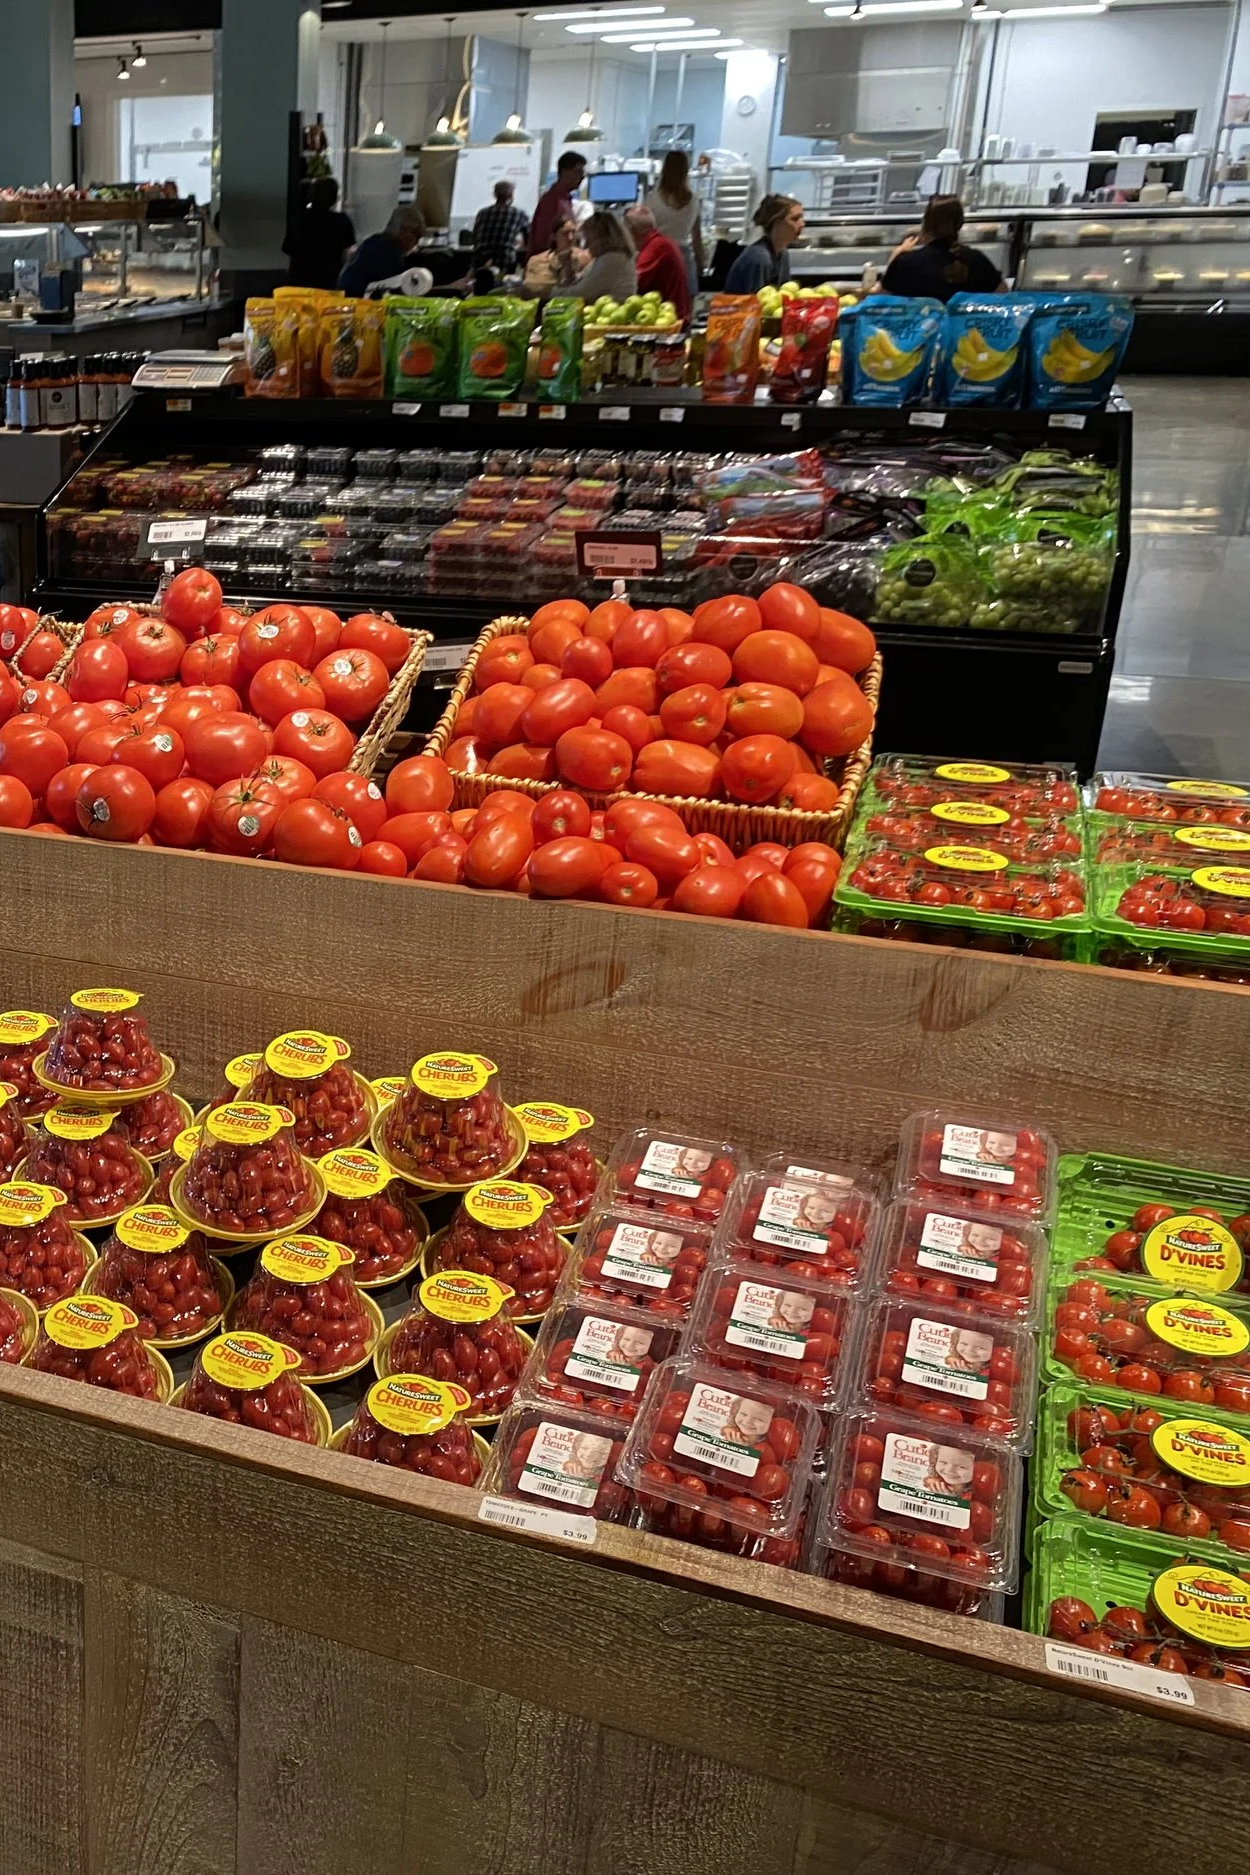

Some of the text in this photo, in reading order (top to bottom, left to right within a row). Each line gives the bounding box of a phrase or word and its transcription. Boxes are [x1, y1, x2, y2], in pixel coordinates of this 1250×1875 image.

[273, 1044, 327, 1065] CHERUBS
[286, 1039, 326, 1053] NATURESWEET
[419, 1068, 478, 1082] CHERUBS
[427, 1061, 472, 1072] NATURESWEET
[50, 1116, 103, 1125] CHERUBS
[214, 1113, 272, 1130] CHERUBS
[226, 1109, 270, 1120] NATURESWEET
[323, 1160, 381, 1183] CHERUBS
[335, 1155, 378, 1172] NATURESWEET
[1, 1190, 43, 1201] NATURESWEET
[472, 1196, 532, 1212] CHERUBS
[480, 1191, 528, 1201] NATURESWEET
[123, 1218, 180, 1237] CHERUBS
[135, 1213, 178, 1225] NATURESWEET
[283, 1242, 328, 1258] NATURESWEET
[1169, 1237, 1220, 1251] NATURESWEET
[270, 1246, 327, 1270] CHERUBS
[1160, 1245, 1226, 1270] D'VINES
[437, 1280, 486, 1294] NATURESWEET
[426, 1286, 492, 1308] CHERUBS
[68, 1303, 111, 1320] NATURESWEET
[54, 1308, 111, 1334] CHERUBS
[1164, 1316, 1233, 1338] D'VINES
[226, 1340, 272, 1360] NATURESWEET
[211, 1345, 271, 1374] CHERUBS
[912, 1361, 977, 1380] Grape Tomatoes
[389, 1384, 440, 1401] NATURESWEET
[375, 1391, 444, 1417] CHERUBS
[687, 1429, 750, 1455] Grape Tomatoes
[1179, 1434, 1237, 1450] NATURESWEET
[1171, 1439, 1246, 1465] D'VINES
[531, 1467, 588, 1486] Grape Tomatoes
[889, 1484, 958, 1505] Grape Tomatoes
[563, 1530, 587, 1540] $3.99
[1181, 1584, 1244, 1602] NATURESWEET
[1051, 1648, 1092, 1662] NatureSweet
[1157, 1686, 1187, 1700] $3.99
